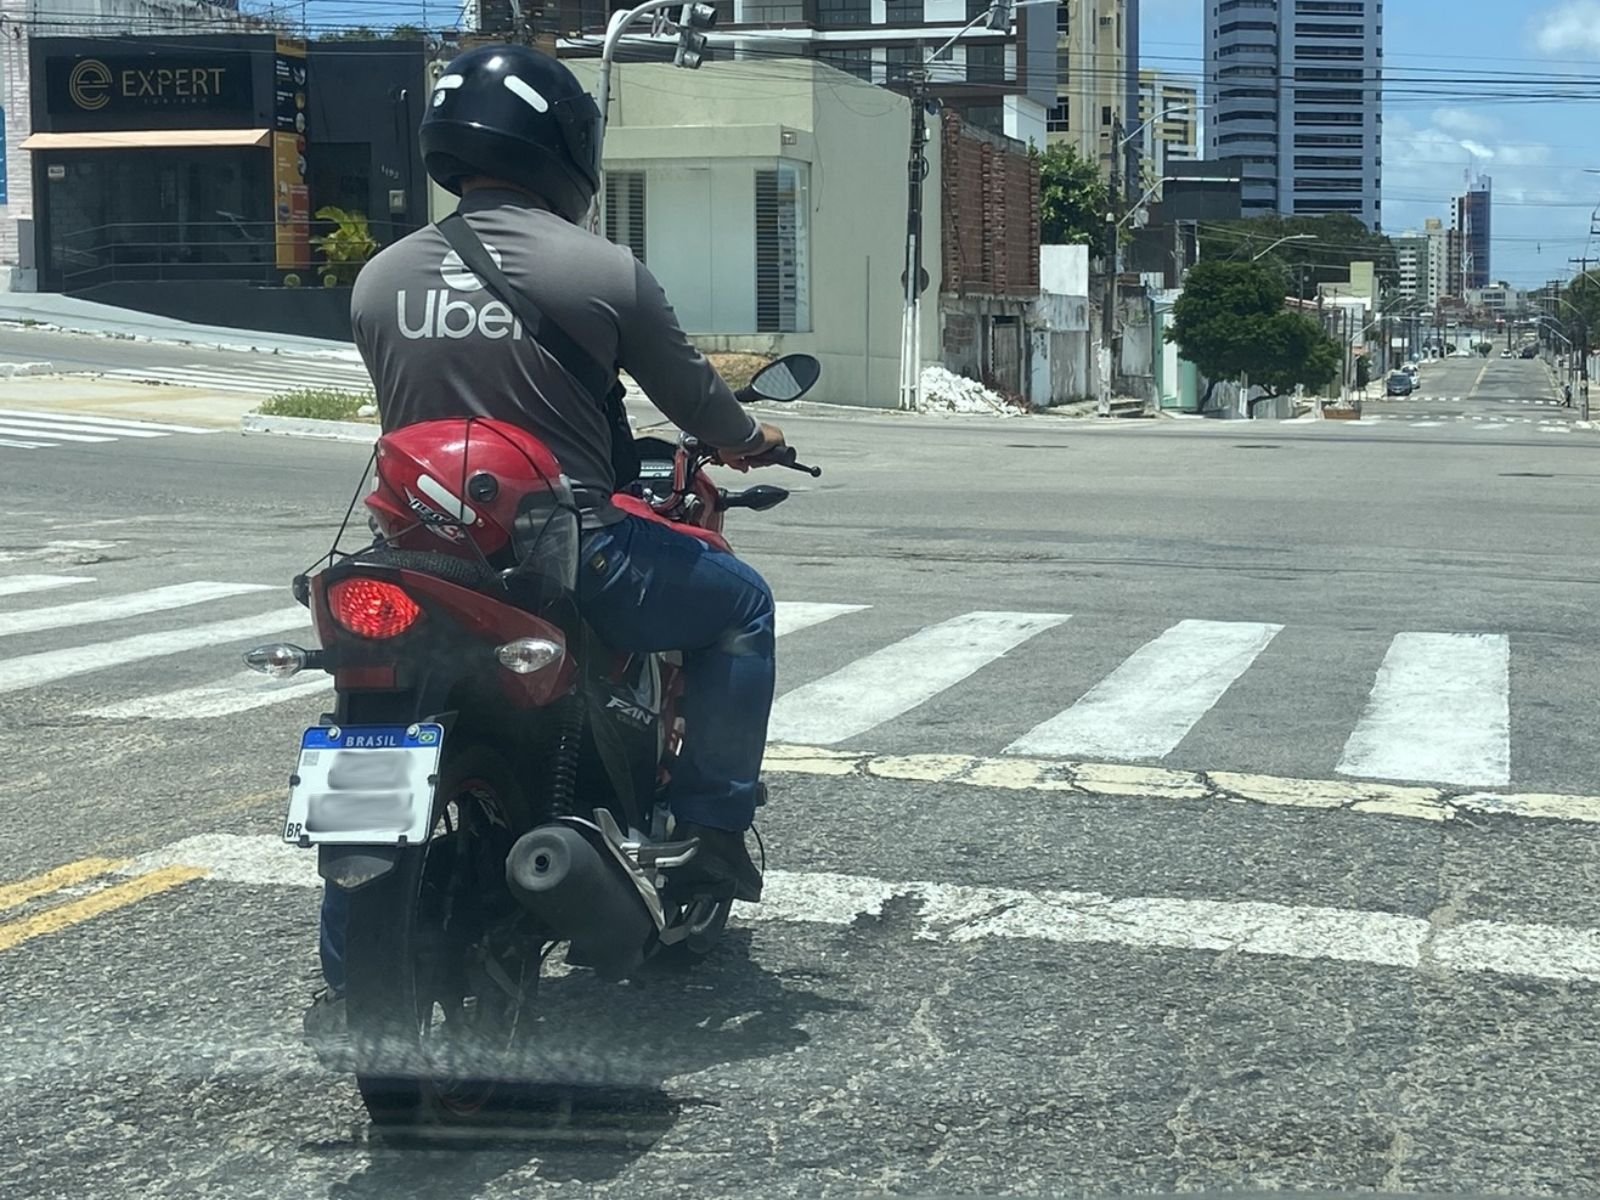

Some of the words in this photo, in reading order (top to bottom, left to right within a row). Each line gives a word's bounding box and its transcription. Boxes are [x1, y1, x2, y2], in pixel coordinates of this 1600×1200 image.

[121, 68, 227, 97] EXPERT
[605, 694, 654, 726] FAN
[345, 735, 397, 747] BRASIL
[286, 822, 302, 838] BR
